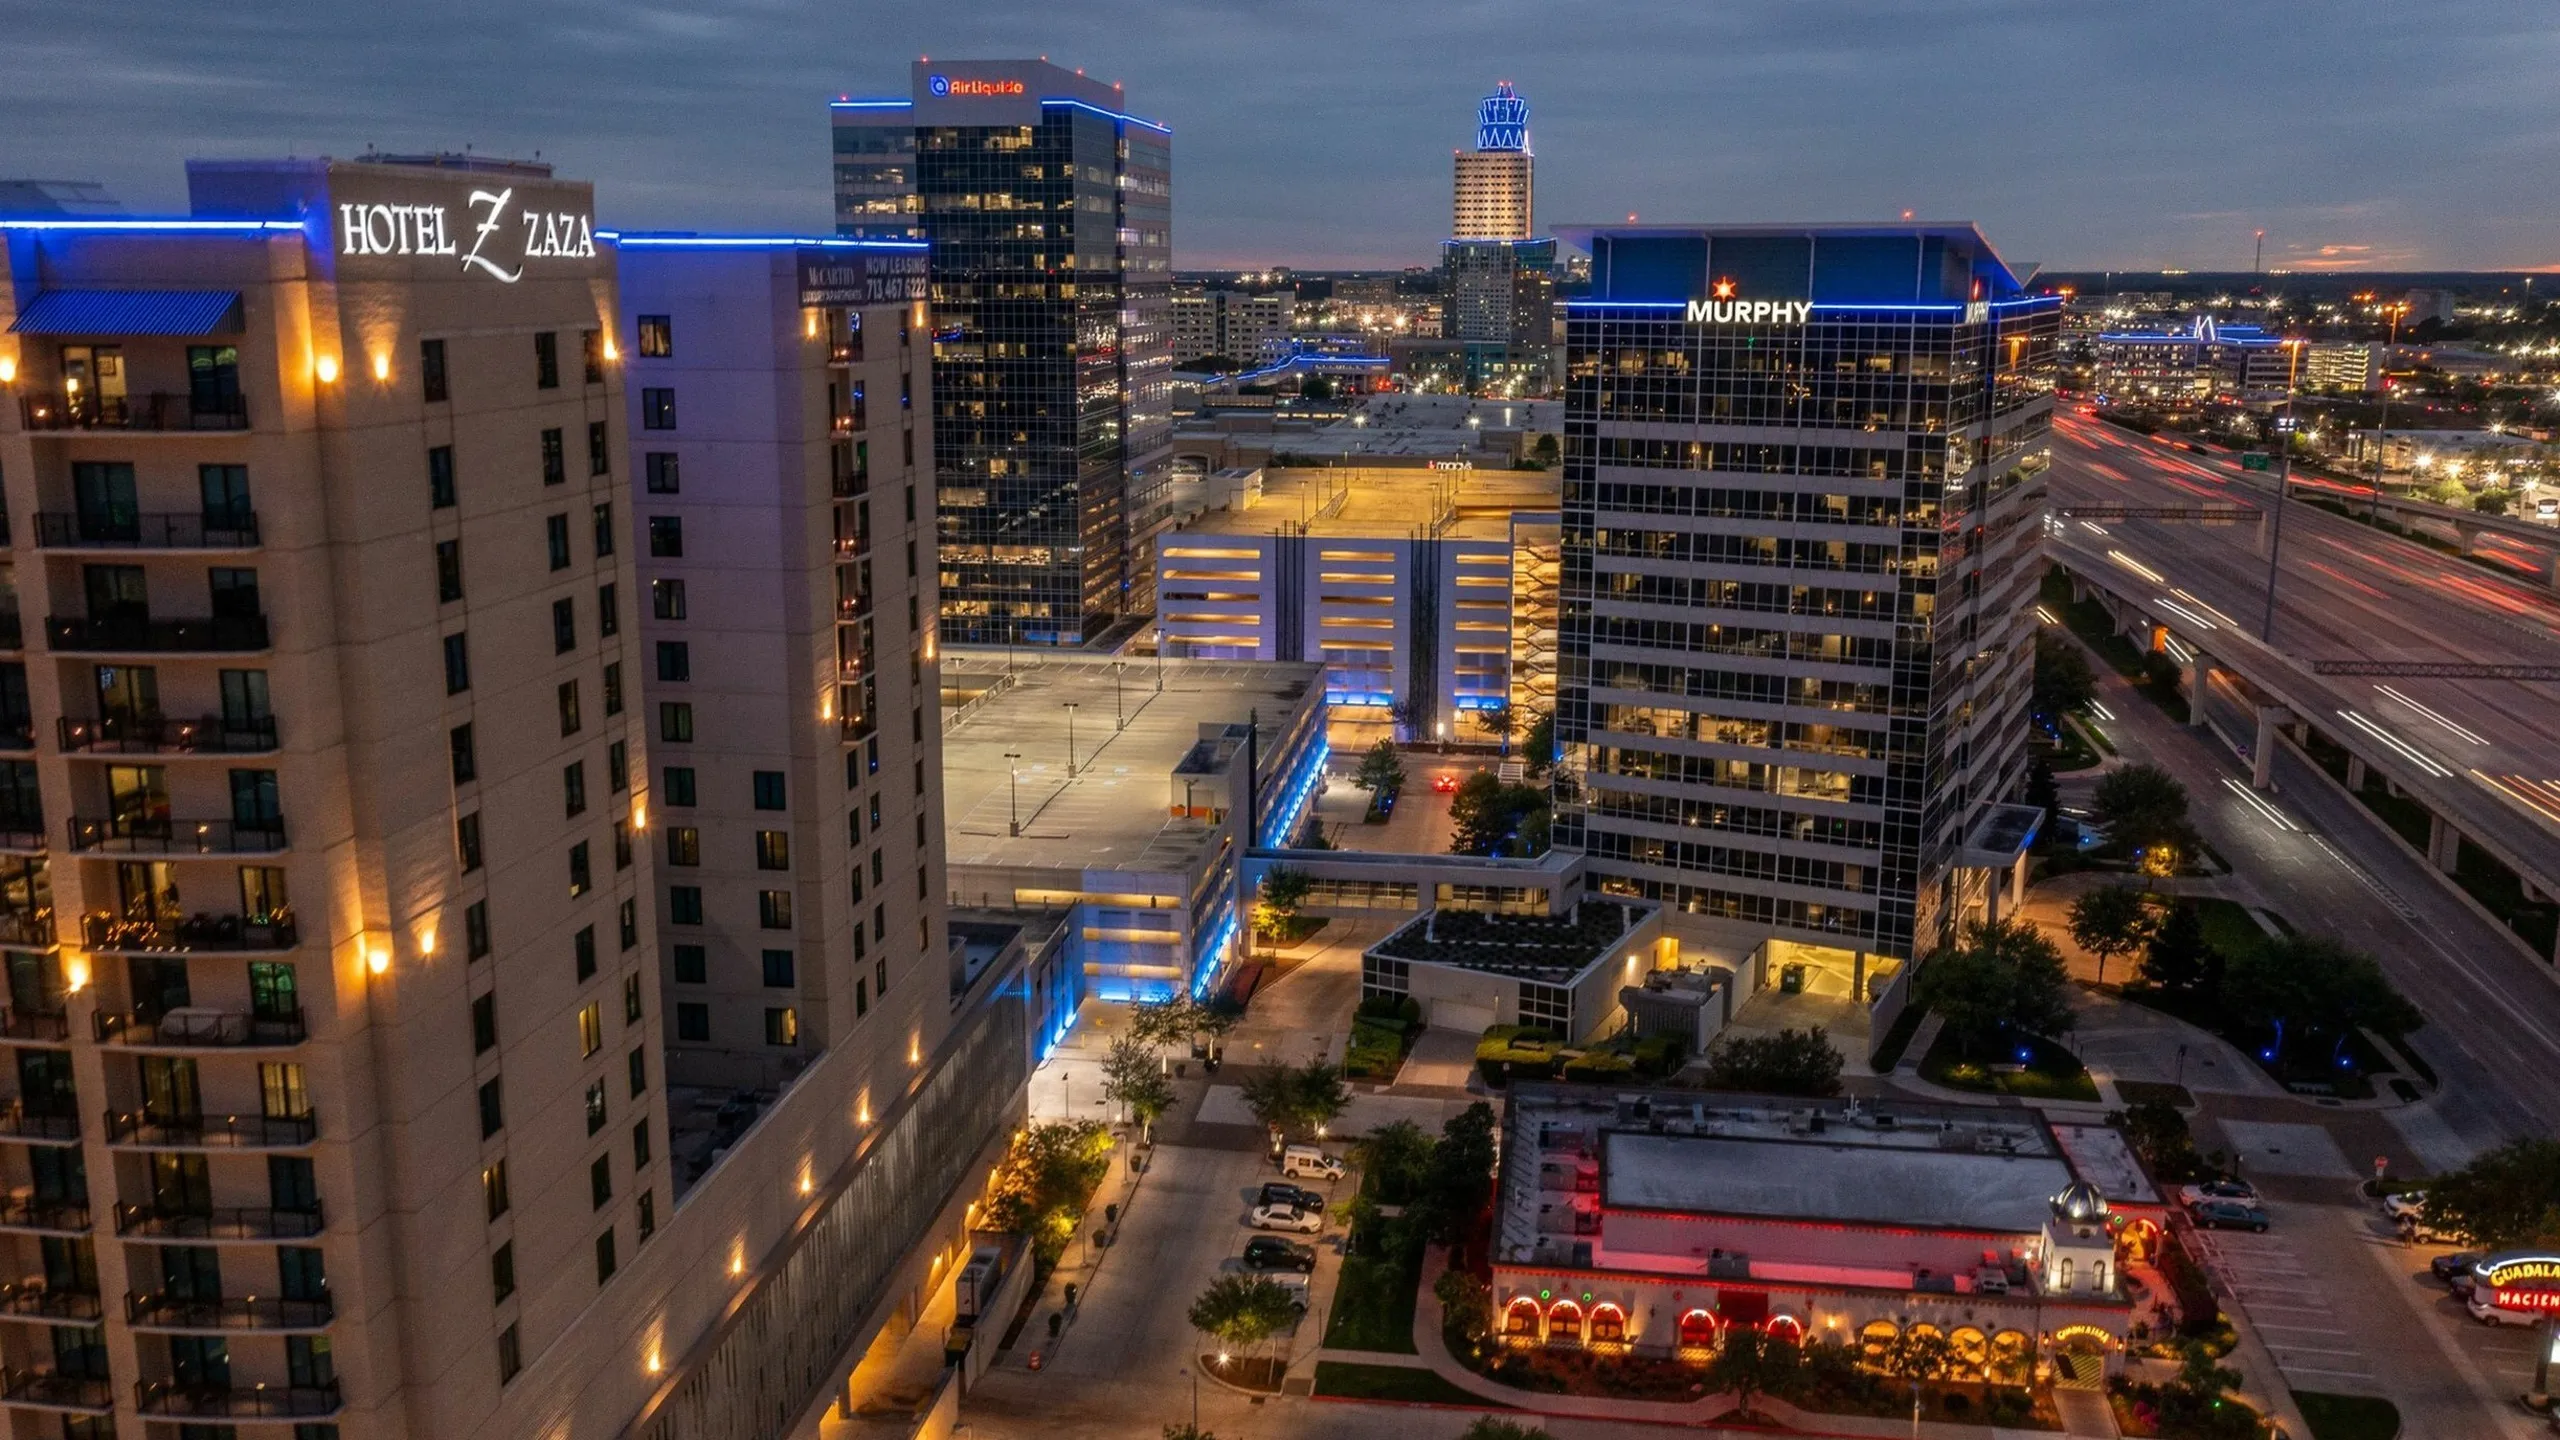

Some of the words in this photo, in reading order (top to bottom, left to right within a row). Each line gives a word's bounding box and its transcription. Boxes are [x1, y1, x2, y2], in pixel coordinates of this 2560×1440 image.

[339, 203, 456, 256] HOTEL
[461, 187, 523, 284] Z
[522, 209, 596, 258] ZAZA
[865, 256, 888, 274] NOW
[890, 256, 926, 274] LEASING
[1687, 300, 1814, 323] MURPHY
